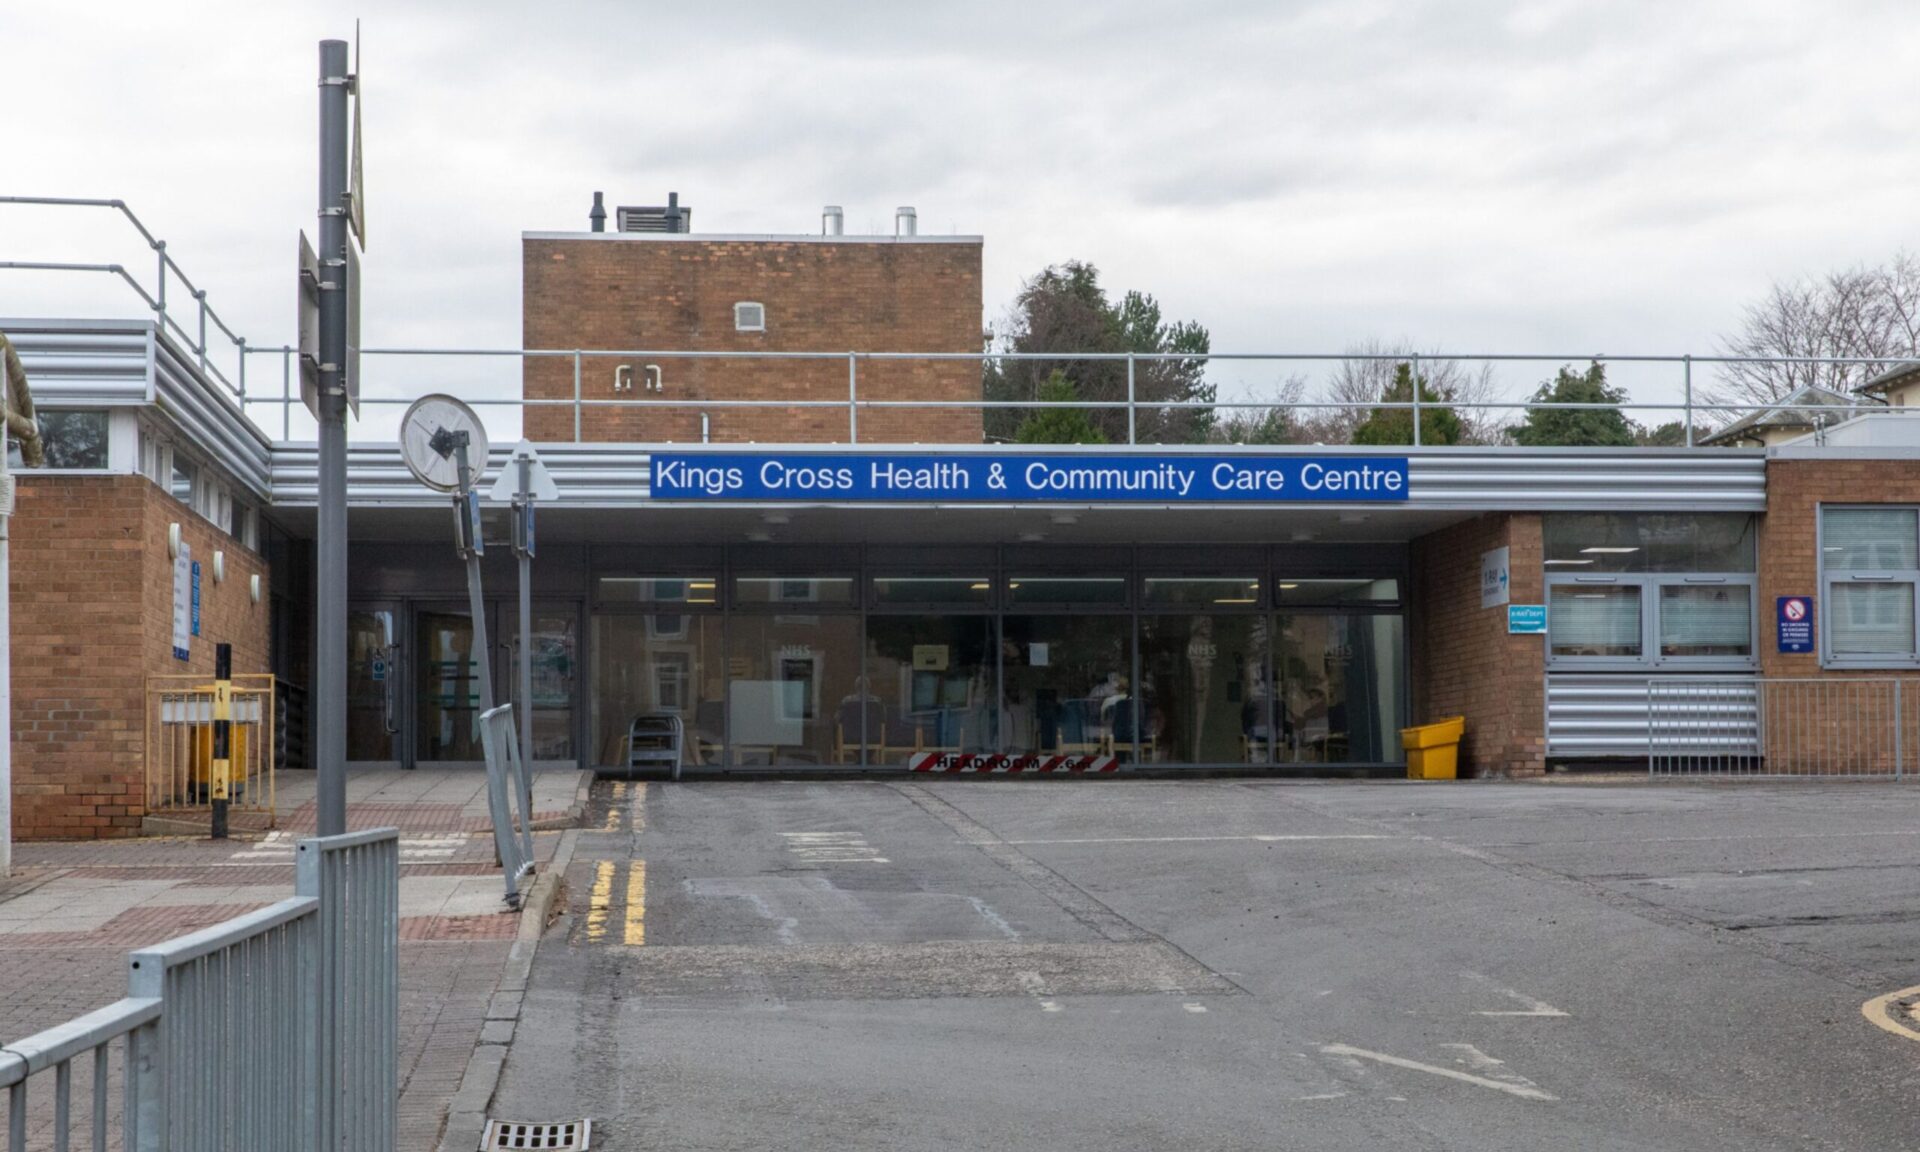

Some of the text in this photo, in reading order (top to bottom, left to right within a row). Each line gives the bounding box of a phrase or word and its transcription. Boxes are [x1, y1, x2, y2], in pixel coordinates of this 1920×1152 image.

[656, 461, 1402, 496] Kings Cross Health & Community Care Centre
[781, 645, 811, 656] NHS
[1188, 644, 1217, 656] NHS
[1324, 645, 1352, 656] NHS
[936, 756, 1040, 770] HEADROOM
